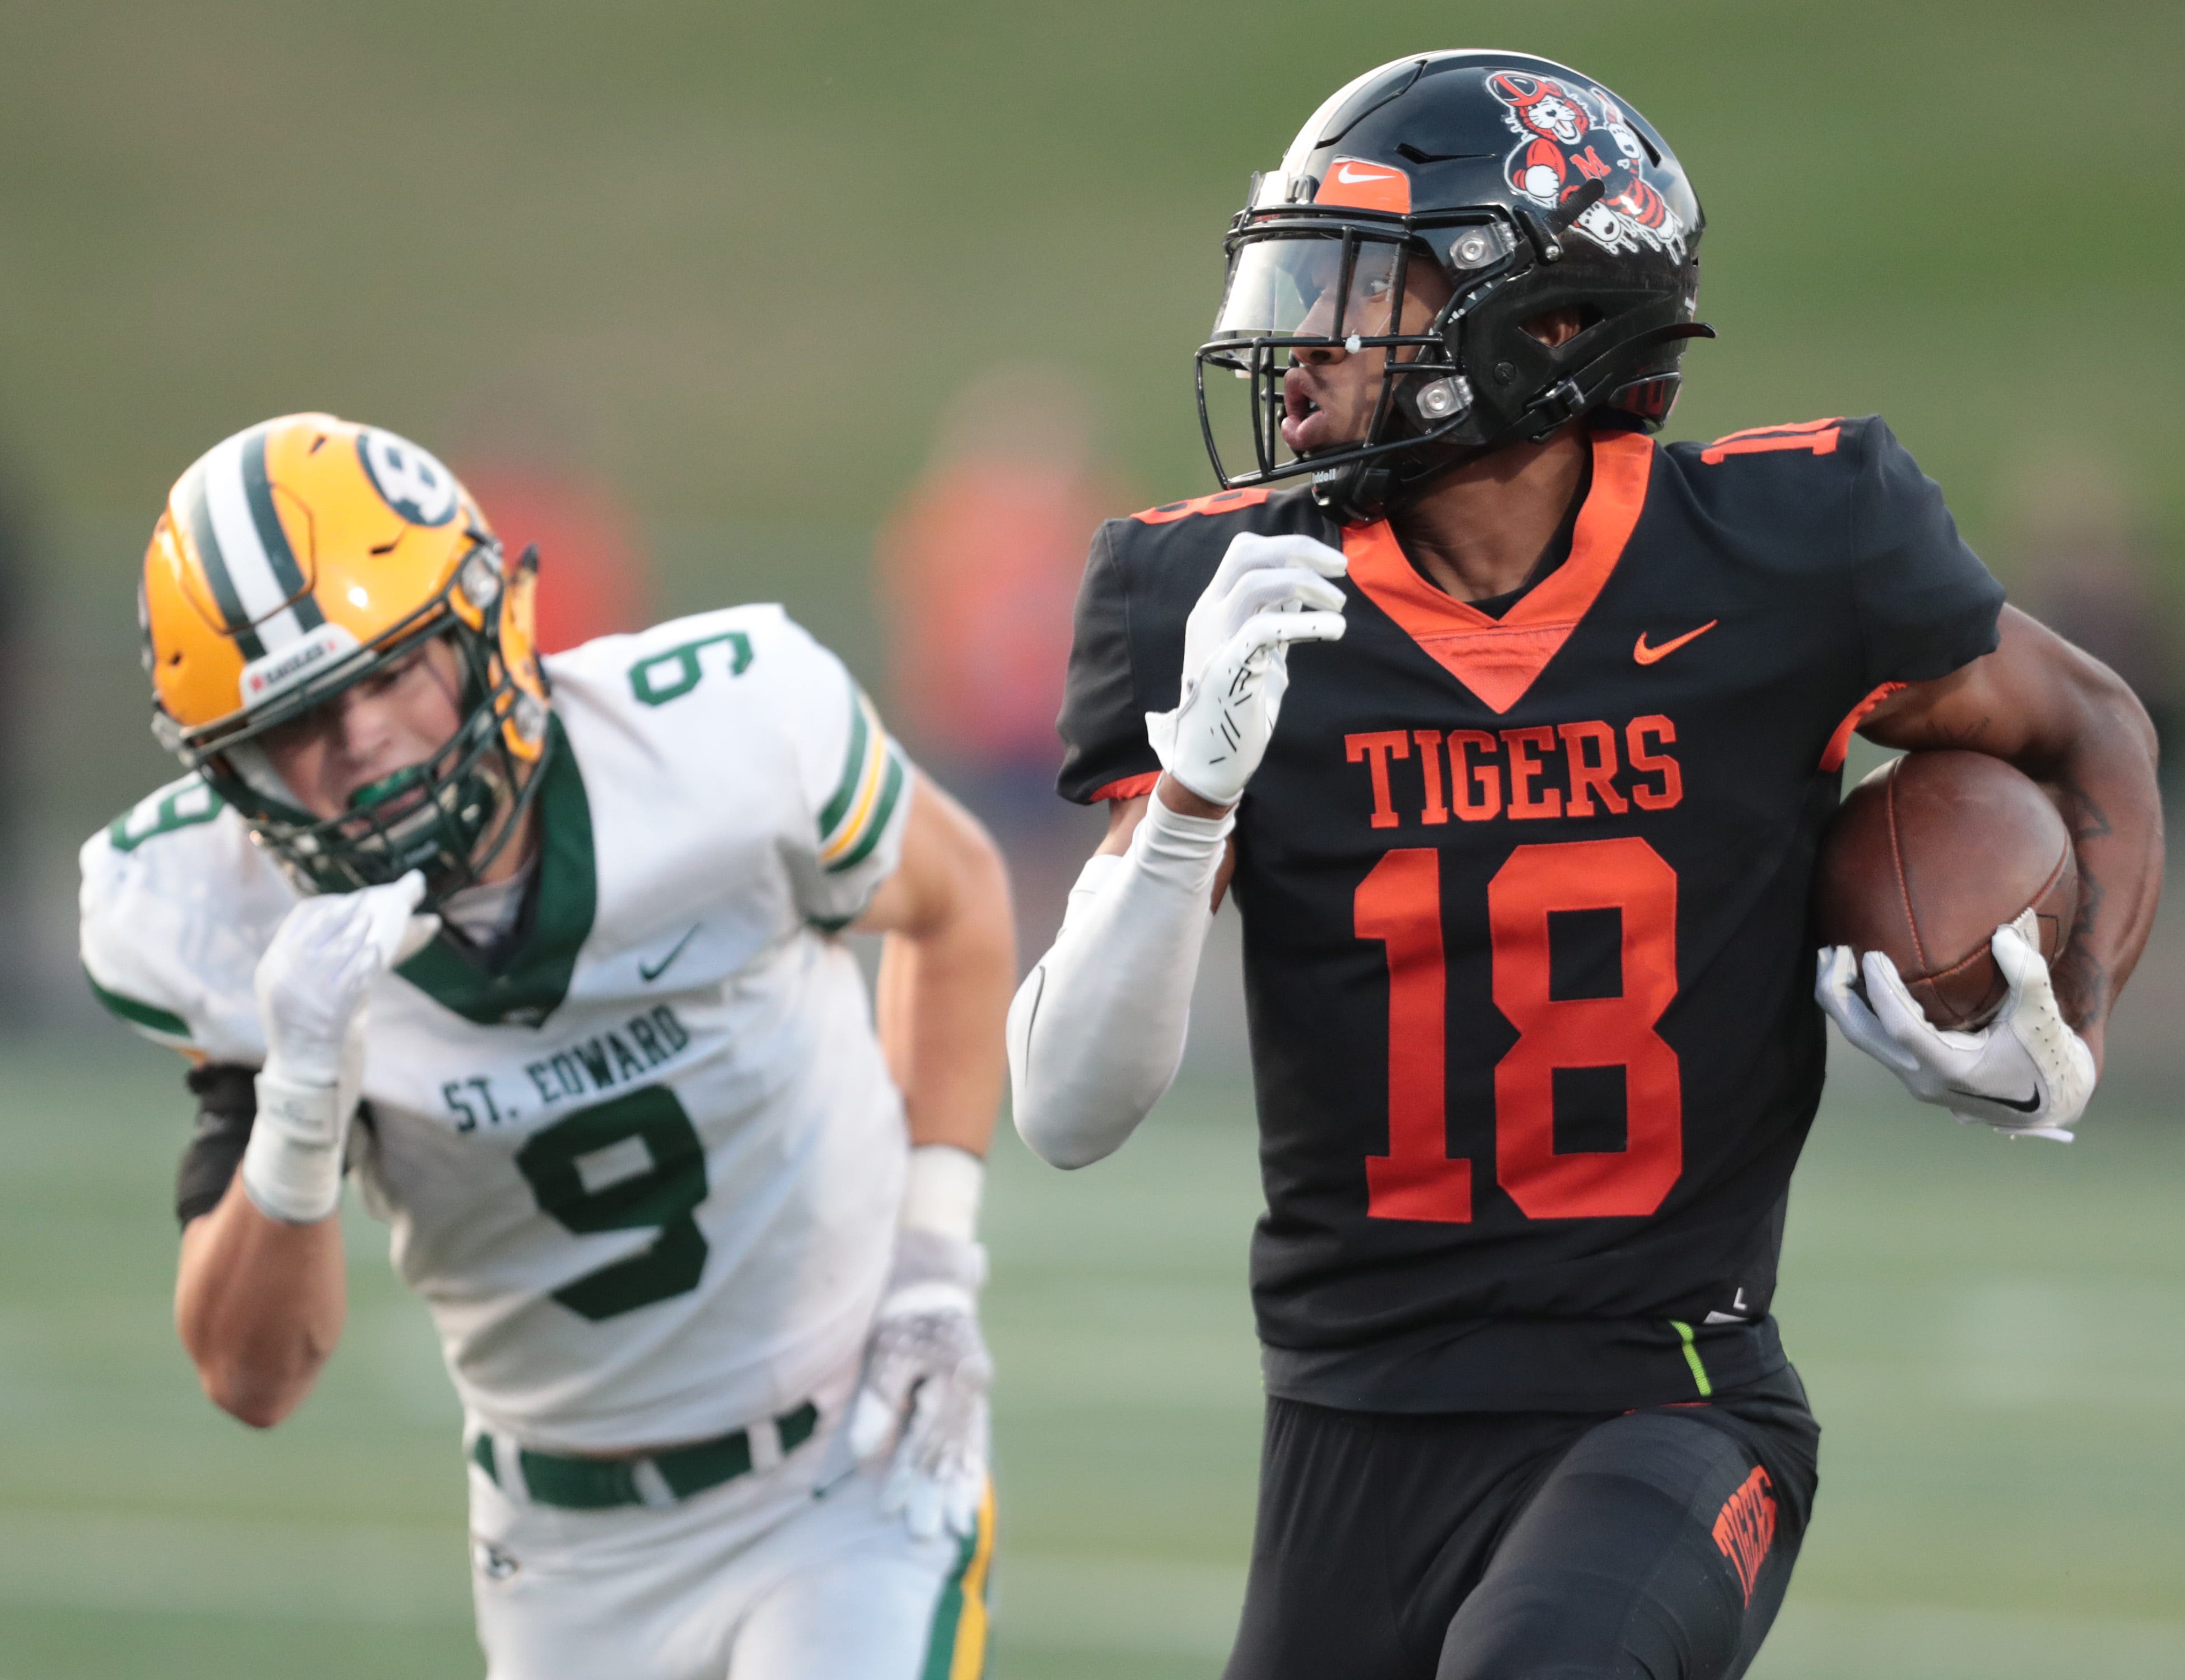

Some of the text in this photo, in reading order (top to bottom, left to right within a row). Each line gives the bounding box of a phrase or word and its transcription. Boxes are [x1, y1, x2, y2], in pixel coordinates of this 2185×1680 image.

[1568, 144, 1612, 180] M
[627, 629, 755, 709] 9
[1344, 713, 1683, 829] TIGERS
[441, 1004, 690, 1133] ST. EDWARD
[1353, 835, 1683, 1224] 18
[513, 1083, 709, 1323] 9
